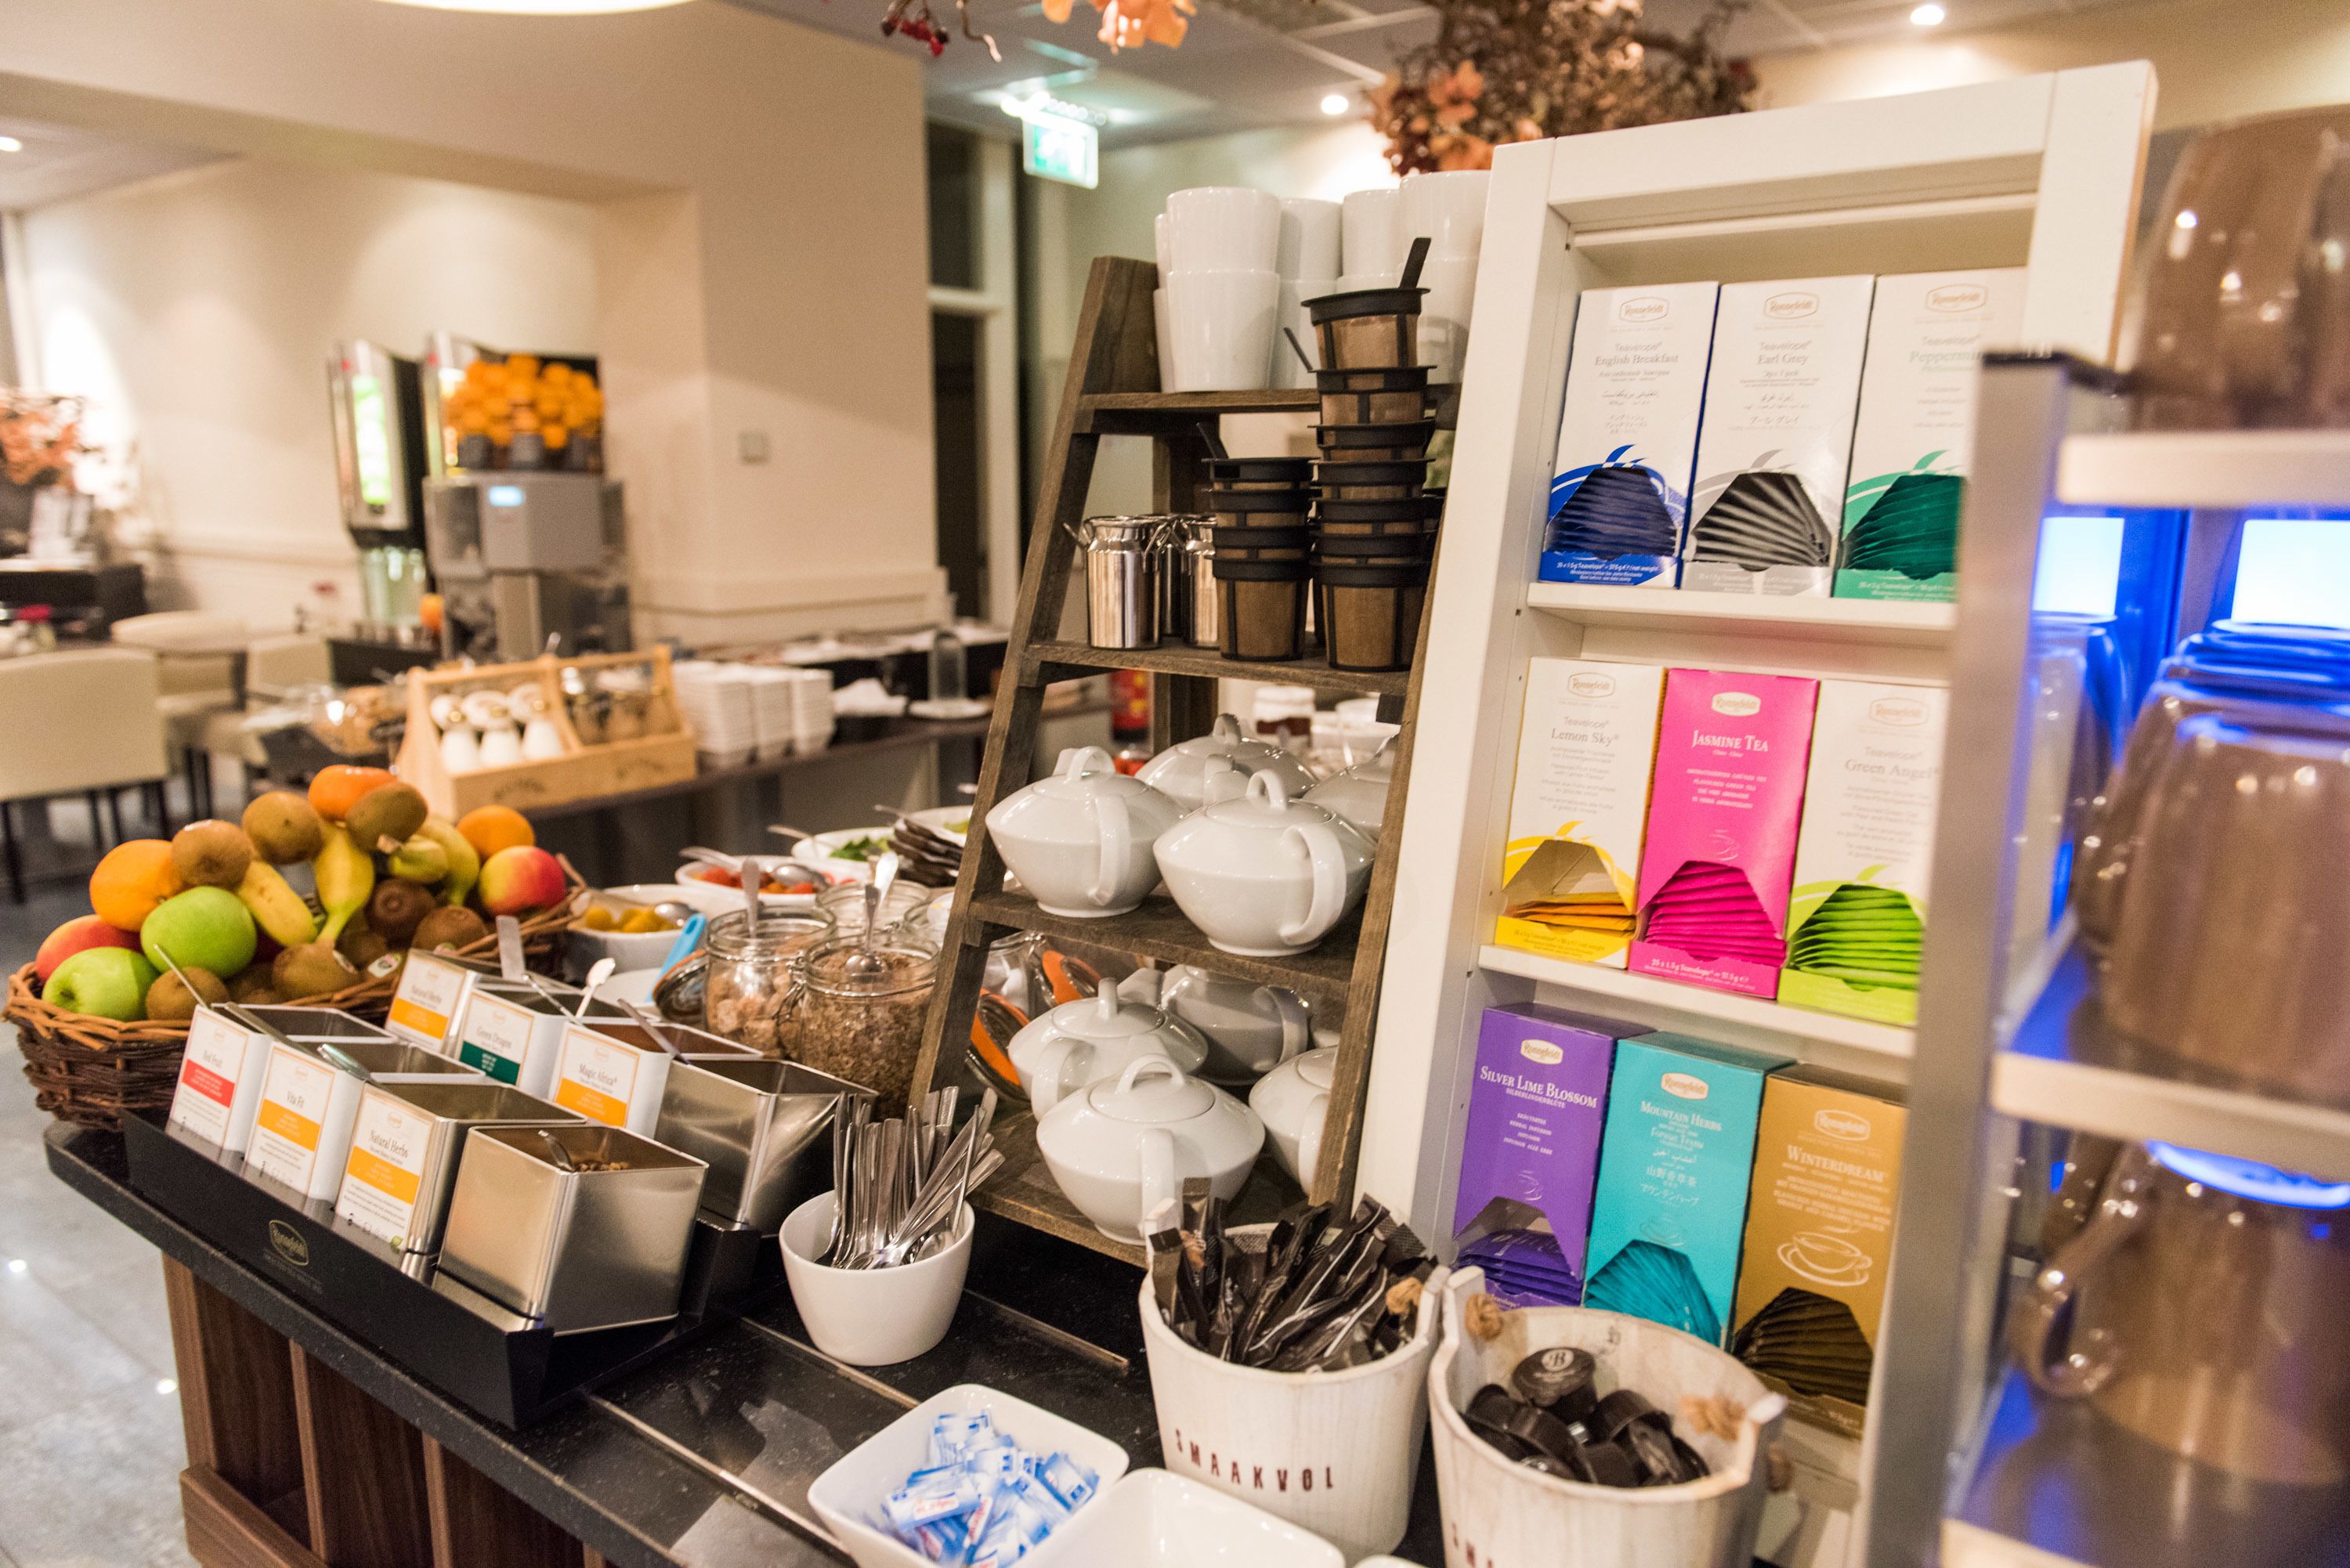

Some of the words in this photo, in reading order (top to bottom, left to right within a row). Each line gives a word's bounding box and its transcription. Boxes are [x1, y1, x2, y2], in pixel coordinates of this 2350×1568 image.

[1595, 355, 1630, 367] English
[1632, 353, 1679, 364] Breakfast
[1757, 354, 1780, 364] Earl
[1782, 353, 1810, 366] Grey
[1551, 728, 1589, 742] Lemon
[1691, 730, 1742, 749] JASMINE
[1744, 735, 1769, 752] TEA
[1845, 759, 1885, 775] Green
[580, 1063, 597, 1079] Magic
[1480, 1065, 1515, 1087] SILVER
[1517, 1075, 1544, 1095] LIME
[1546, 1082, 1598, 1108] BLOSSOM
[287, 1089, 297, 1105] Vita
[1640, 1100, 1689, 1123] MOUNTAIN
[1690, 1114, 1723, 1132] HERBS
[369, 1129, 391, 1150] Natural
[391, 1136, 409, 1159] Herbs
